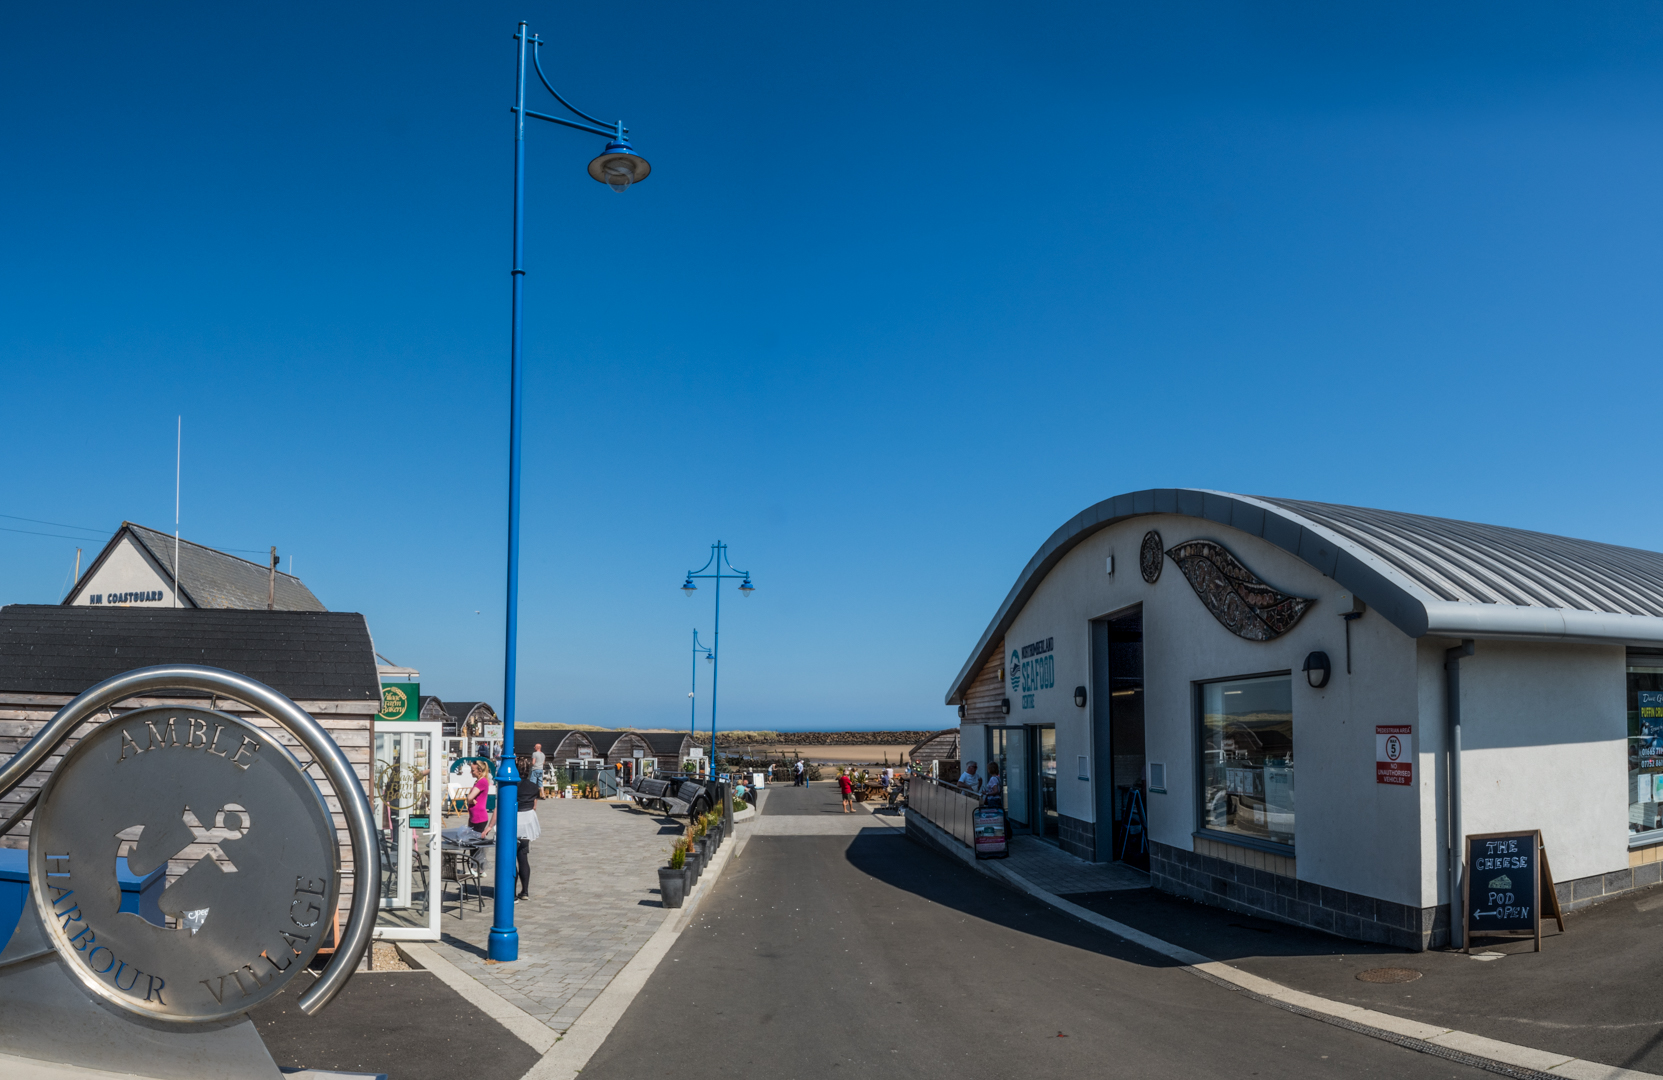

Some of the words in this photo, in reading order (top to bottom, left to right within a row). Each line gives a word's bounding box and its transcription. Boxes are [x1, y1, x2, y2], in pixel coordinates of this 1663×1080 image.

[90, 594, 102, 604] HM
[107, 590, 164, 604] COASTGUARD
[1022, 654, 1054, 692] SEAFOOD
[1641, 707, 1654, 718] PUFFIN
[117, 717, 260, 770] AMBLE
[1391, 744, 1396, 753] 5
[386, 790, 421, 802] Bakery
[1486, 840, 1518, 854] THE
[1476, 856, 1528, 870] CHEESE
[1488, 892, 1514, 905] POD
[1496, 906, 1529, 919] OPEN
[44, 852, 167, 1006] HARBOUR
[200, 875, 326, 1005] VILLAGE
